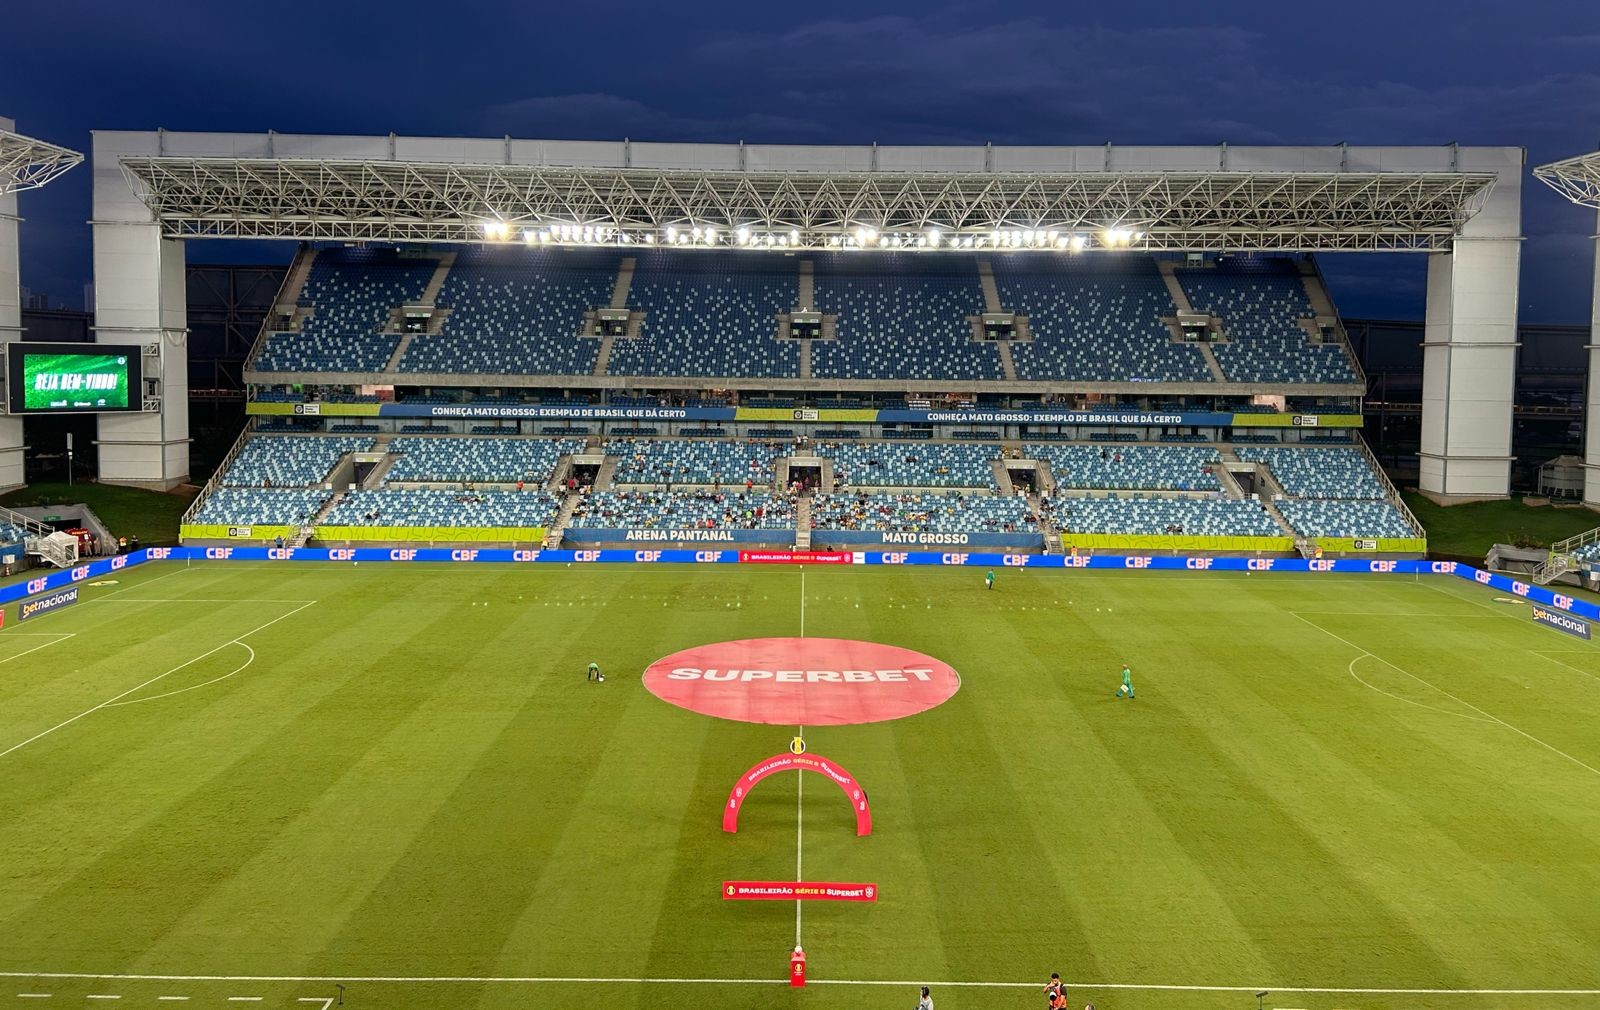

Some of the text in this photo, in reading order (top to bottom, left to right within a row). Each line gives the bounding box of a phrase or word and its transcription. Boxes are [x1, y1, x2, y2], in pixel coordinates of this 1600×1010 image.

[432, 407, 472, 416] CONHEÇA
[474, 407, 498, 416] MATO
[500, 408, 538, 416] GROSSO:
[540, 408, 580, 416] EXEMPLO
[582, 409, 593, 417] DE
[595, 409, 625, 417] BRASIL
[627, 409, 644, 418] QUE
[646, 408, 657, 417] DÁ
[927, 412, 967, 422] CONHEÇA
[969, 413, 993, 421] MATO
[995, 413, 1032, 421] GROSSO:
[1034, 414, 1074, 422] EXEMPLO
[1076, 414, 1087, 422] DE
[1121, 415, 1139, 423] QUE
[1141, 413, 1152, 423] DÁ
[1154, 415, 1182, 424] CERTO
[625, 530, 734, 541] ARENA PANTANAL
[882, 532, 968, 544] MATO GROSSO
[146, 547, 171, 559] CBF
[206, 548, 233, 559] CBF
[268, 548, 294, 560] CBF
[329, 549, 356, 560] CBF
[390, 549, 417, 561] CBF
[452, 550, 478, 561] CBF
[513, 550, 540, 562] CBF
[574, 551, 601, 562] CBF
[635, 551, 662, 562] CBF
[696, 551, 722, 562] CBF
[882, 552, 909, 564] CBF
[942, 553, 969, 564] CBF
[111, 555, 128, 569] CBF
[1003, 554, 1030, 566] CBF
[1064, 555, 1091, 567] CBF
[1125, 557, 1152, 568] CBF
[1186, 558, 1213, 569] CBF
[1247, 558, 1274, 570] CBF
[1308, 559, 1335, 571] CBF
[1370, 560, 1397, 572] CBF
[71, 565, 90, 580] CBF
[1432, 561, 1457, 573] CBF
[1475, 569, 1491, 584] CBF
[27, 577, 48, 594] CBF
[1512, 581, 1530, 596] CBF
[23, 589, 77, 618] betnacional
[1553, 594, 1574, 610] CBF
[1532, 607, 1586, 634] betnacional
[667, 668, 934, 683] SUPERBET
[748, 759, 791, 781] BRASILEIRÃO
[820, 762, 851, 784] SUPERBET
[795, 887, 819, 895] SÉRIE
[827, 888, 864, 896] SUPERBET
